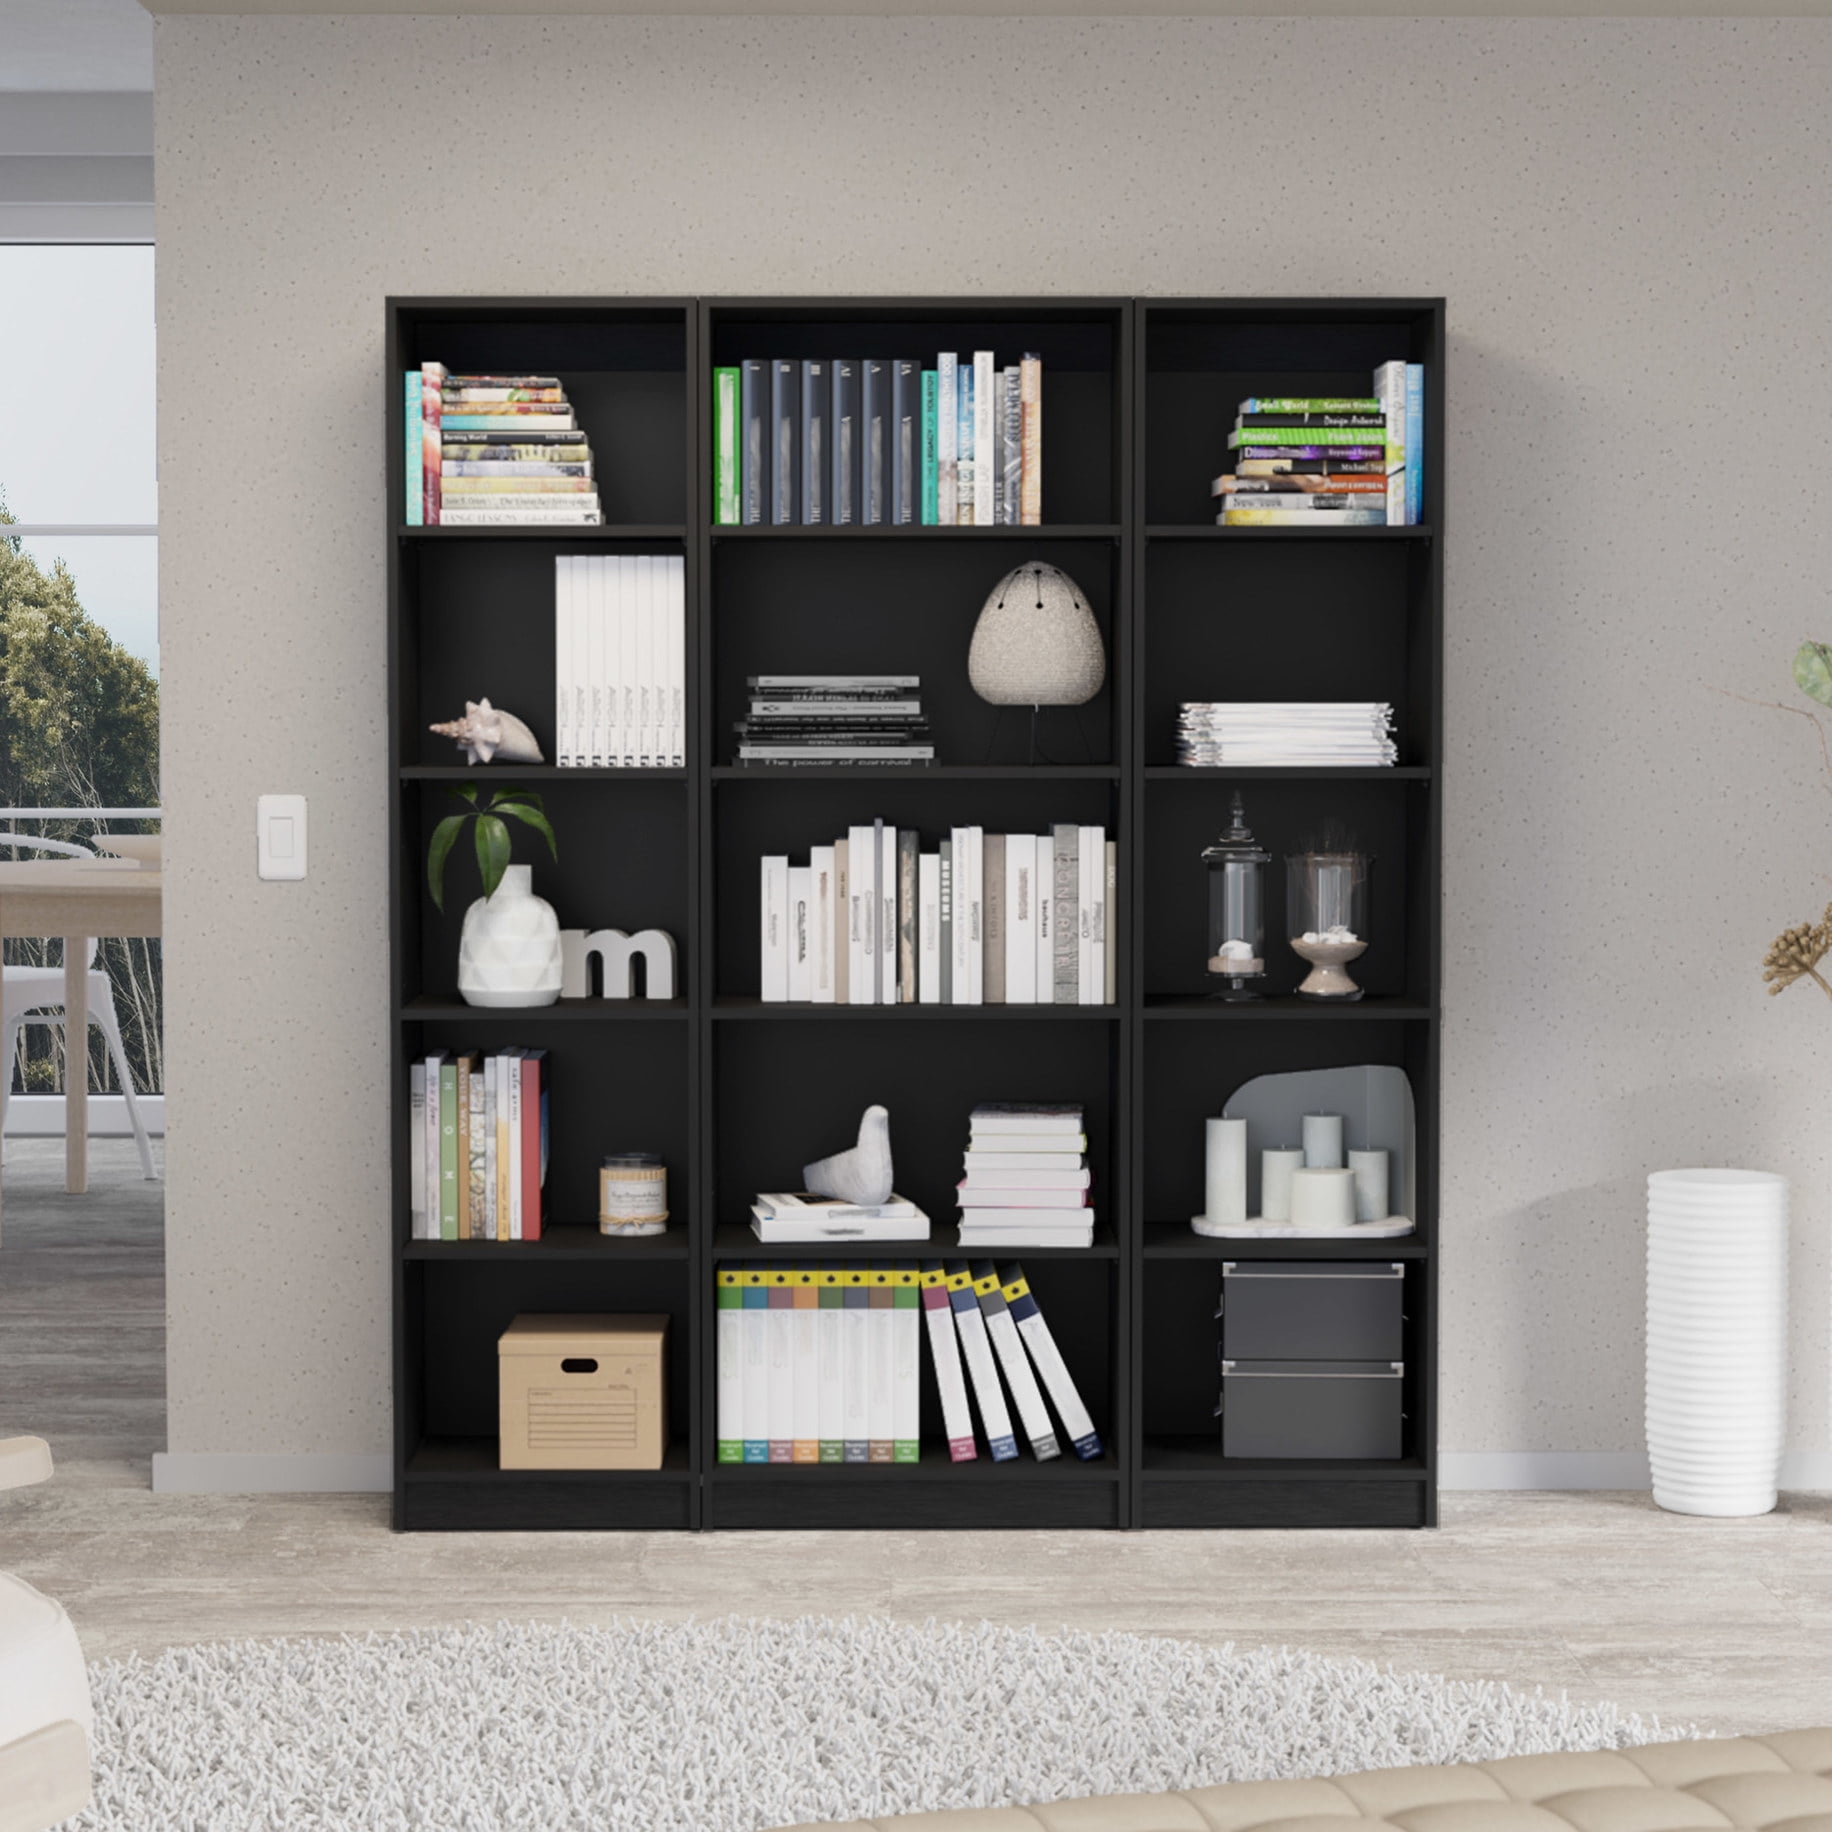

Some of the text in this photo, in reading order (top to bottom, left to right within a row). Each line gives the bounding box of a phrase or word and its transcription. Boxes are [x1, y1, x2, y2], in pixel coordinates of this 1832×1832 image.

[926, 374, 934, 413] TOLSTOY
[926, 429, 934, 463] LEGACY
[942, 860, 950, 922] MUSEUMS
[444, 1082, 454, 1223] HOME
